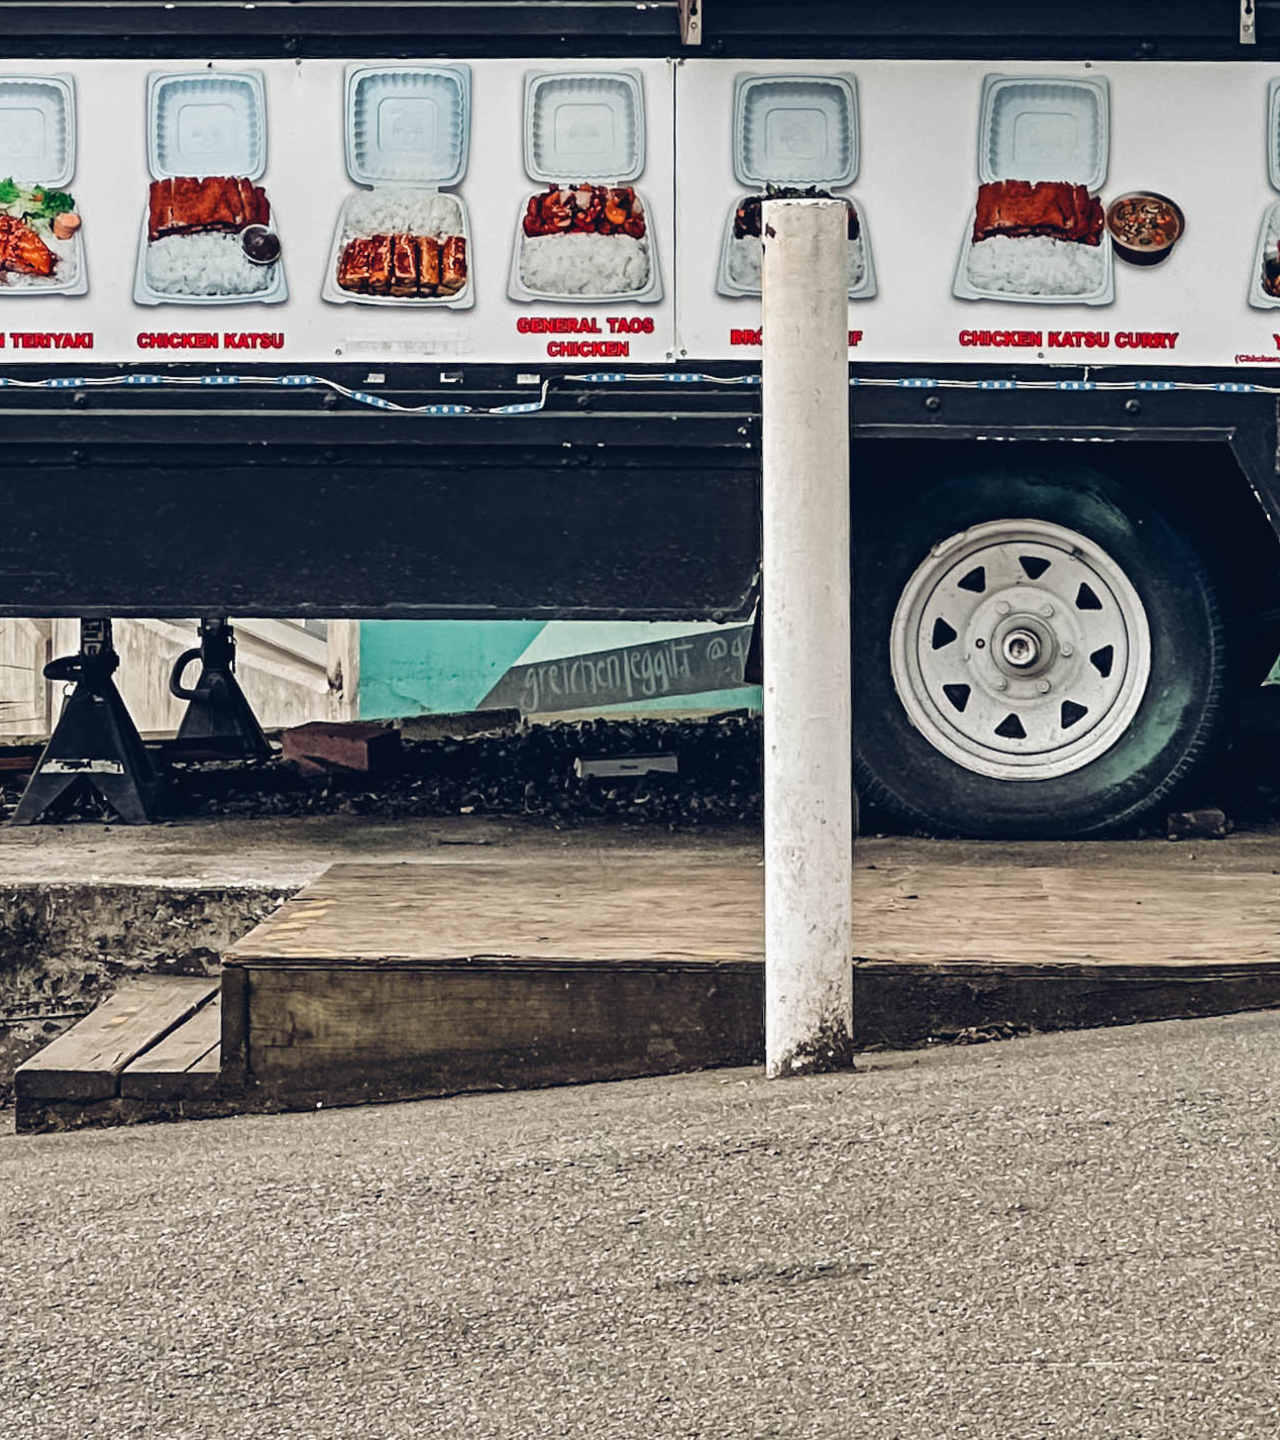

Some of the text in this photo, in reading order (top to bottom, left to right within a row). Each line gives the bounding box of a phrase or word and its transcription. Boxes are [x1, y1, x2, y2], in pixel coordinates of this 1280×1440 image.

[517, 317, 654, 334] GENERAL TAOS
[9, 332, 94, 349] TERIYAKI
[136, 332, 285, 350] CHICKEN KATSU
[959, 329, 1180, 350] CHICKEN KATSU CURRY
[546, 340, 630, 357] CHICKEN
